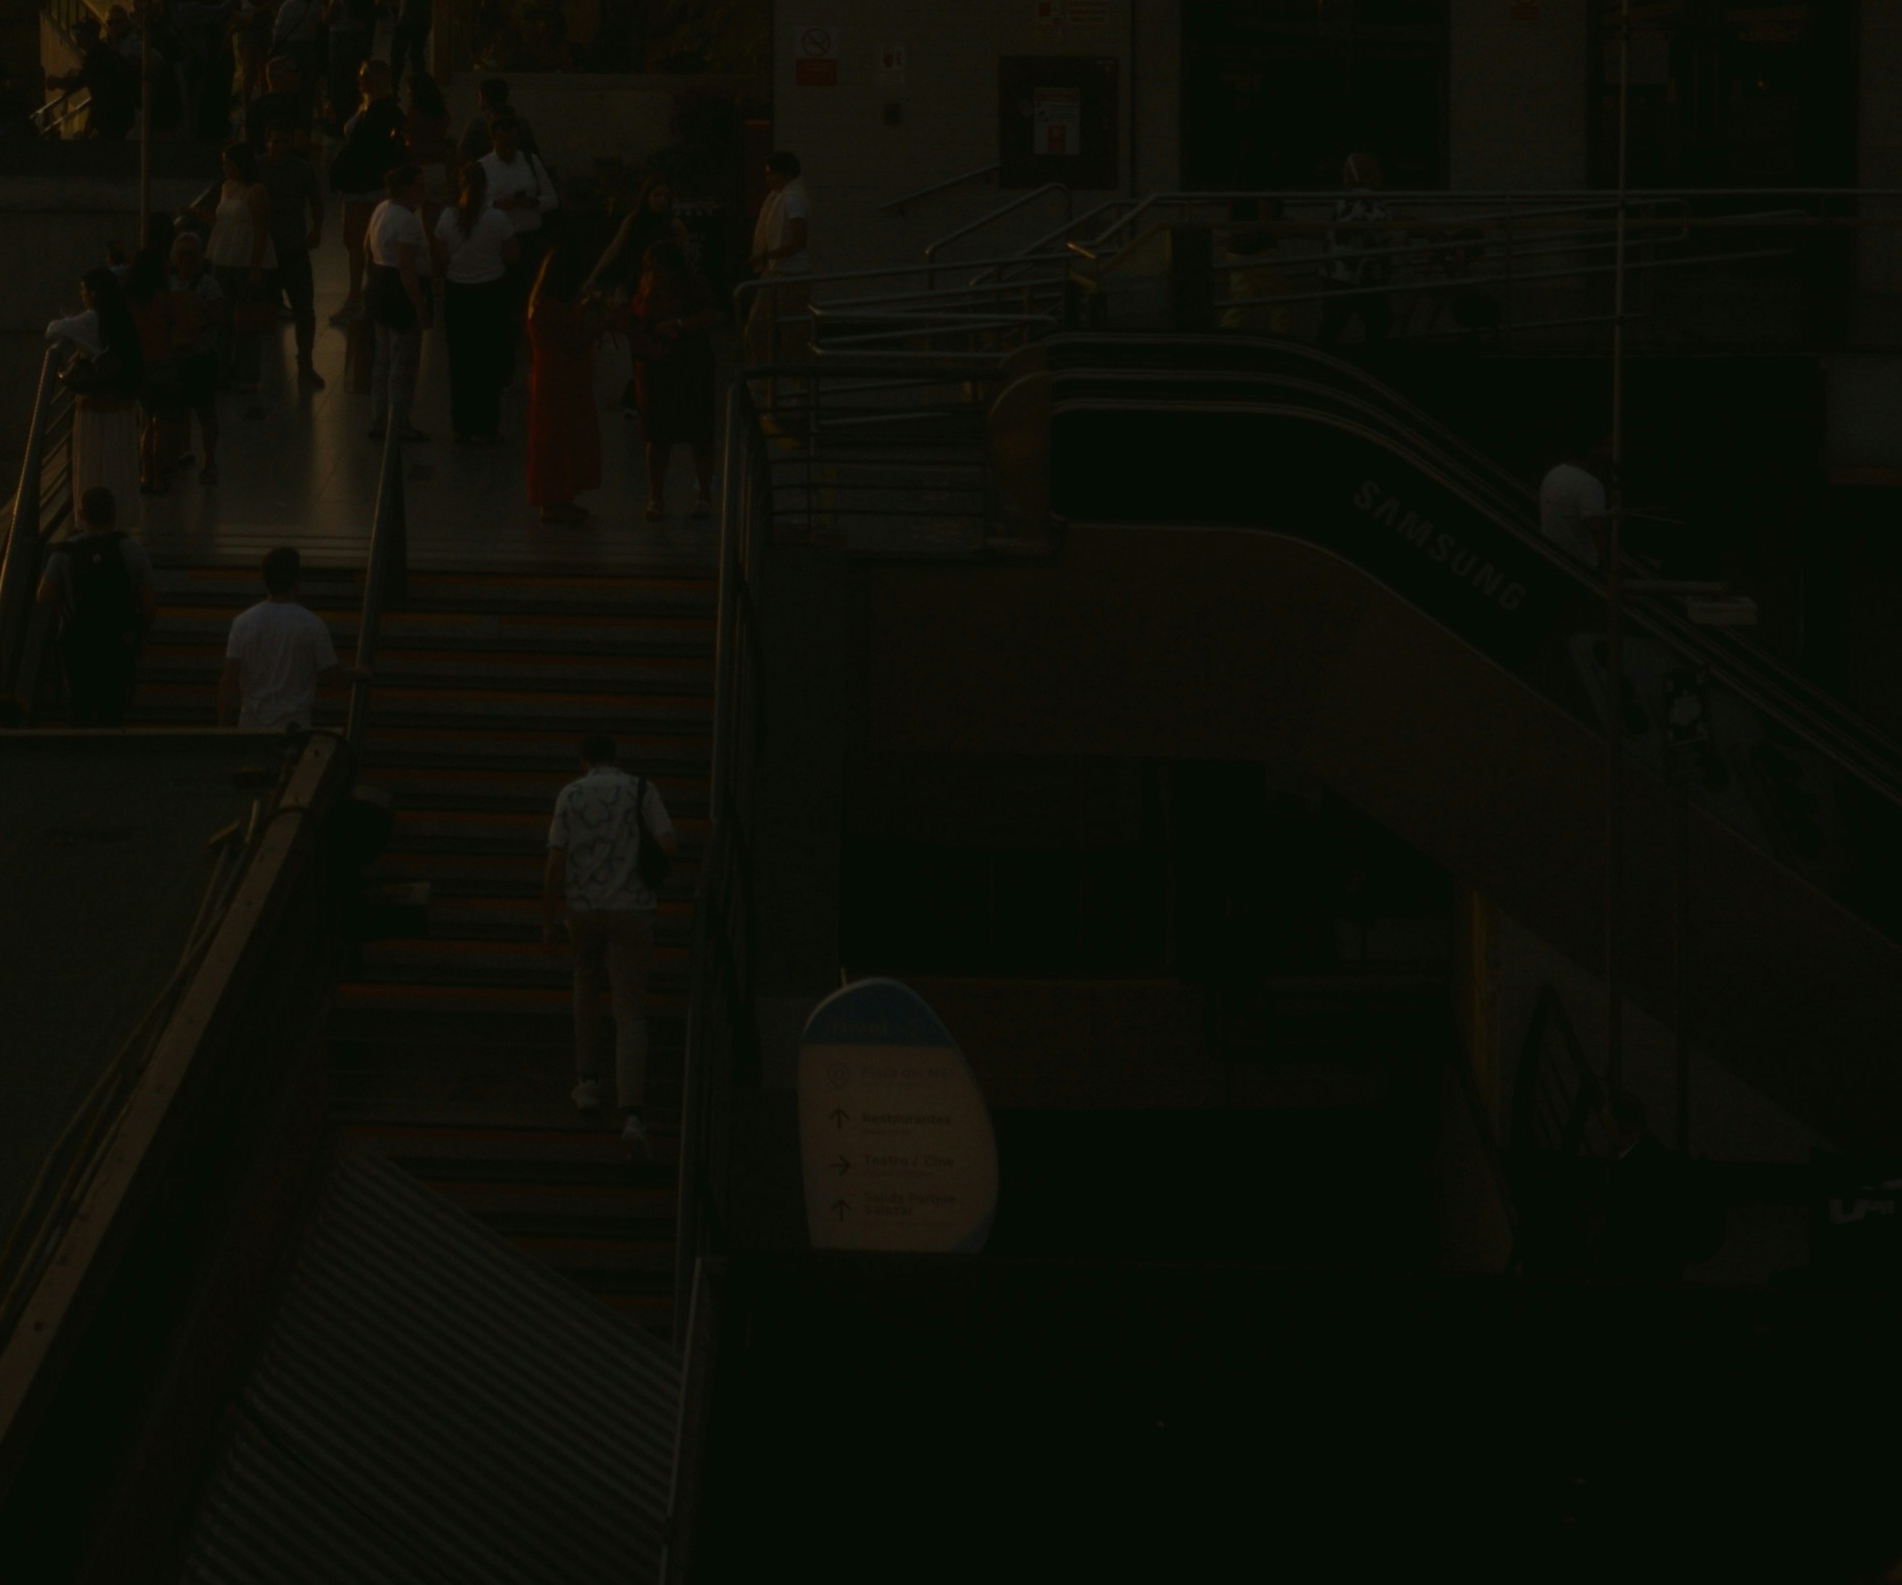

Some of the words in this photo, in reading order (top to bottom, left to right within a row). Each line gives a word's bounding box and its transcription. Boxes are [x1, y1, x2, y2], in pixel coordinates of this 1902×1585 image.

[1352, 479, 1527, 612] SAMSUNG
[862, 1111, 952, 1126] Restaurantes
[863, 1154, 909, 1168] Teatro
[924, 1155, 955, 1168] Cine
[909, 1193, 957, 1208] Parque
